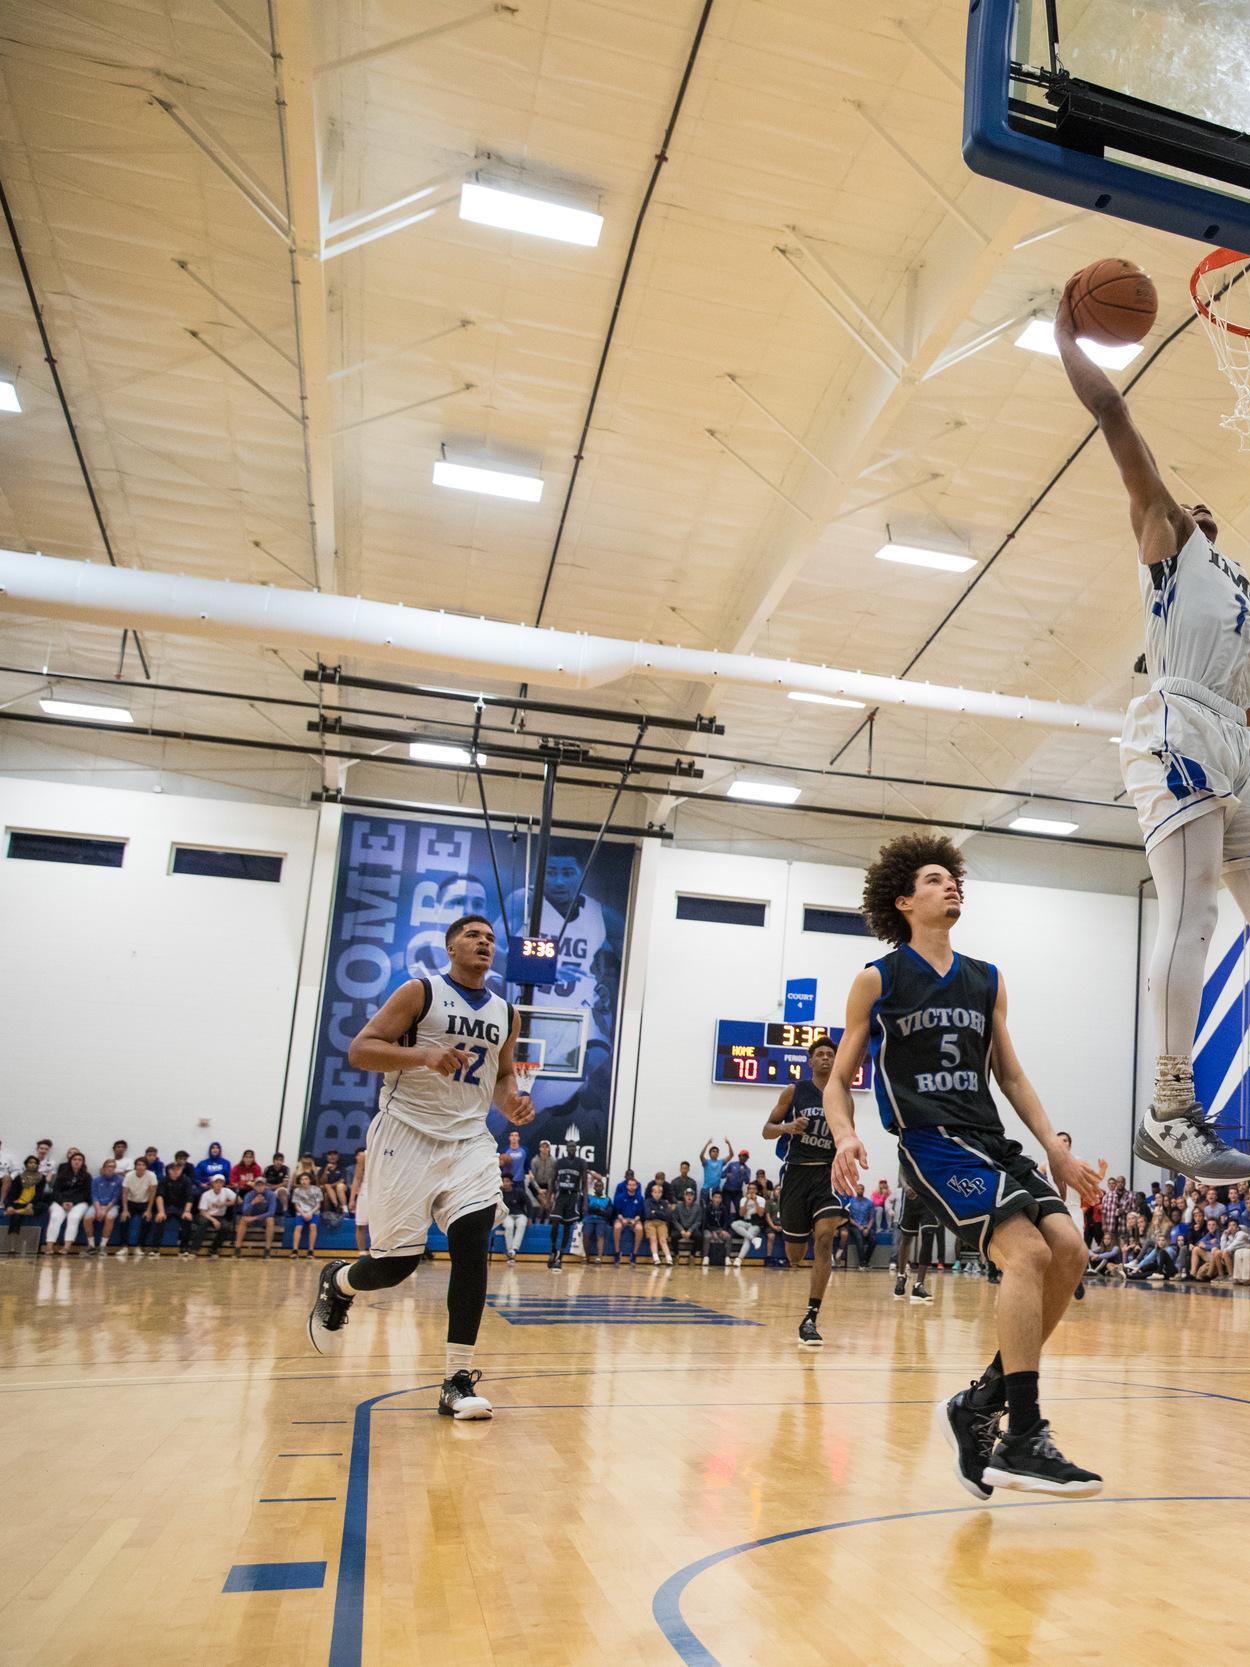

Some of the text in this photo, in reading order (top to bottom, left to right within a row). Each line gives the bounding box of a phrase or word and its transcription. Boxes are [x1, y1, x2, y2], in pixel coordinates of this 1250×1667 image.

[405, 826, 472, 981] ORE
[522, 940, 555, 958] 3:36
[313, 820, 406, 1158] BECOME
[787, 992, 815, 1001] COURT
[445, 1014, 500, 1045] IMG
[731, 1045, 755, 1057] HOME
[940, 1033, 961, 1068] 5
[453, 1042, 488, 1086] 12
[733, 1058, 758, 1080] 70
[789, 1064, 801, 1080] 4
[800, 1133, 833, 1150] ROCK
[946, 1174, 987, 1198] VRP
